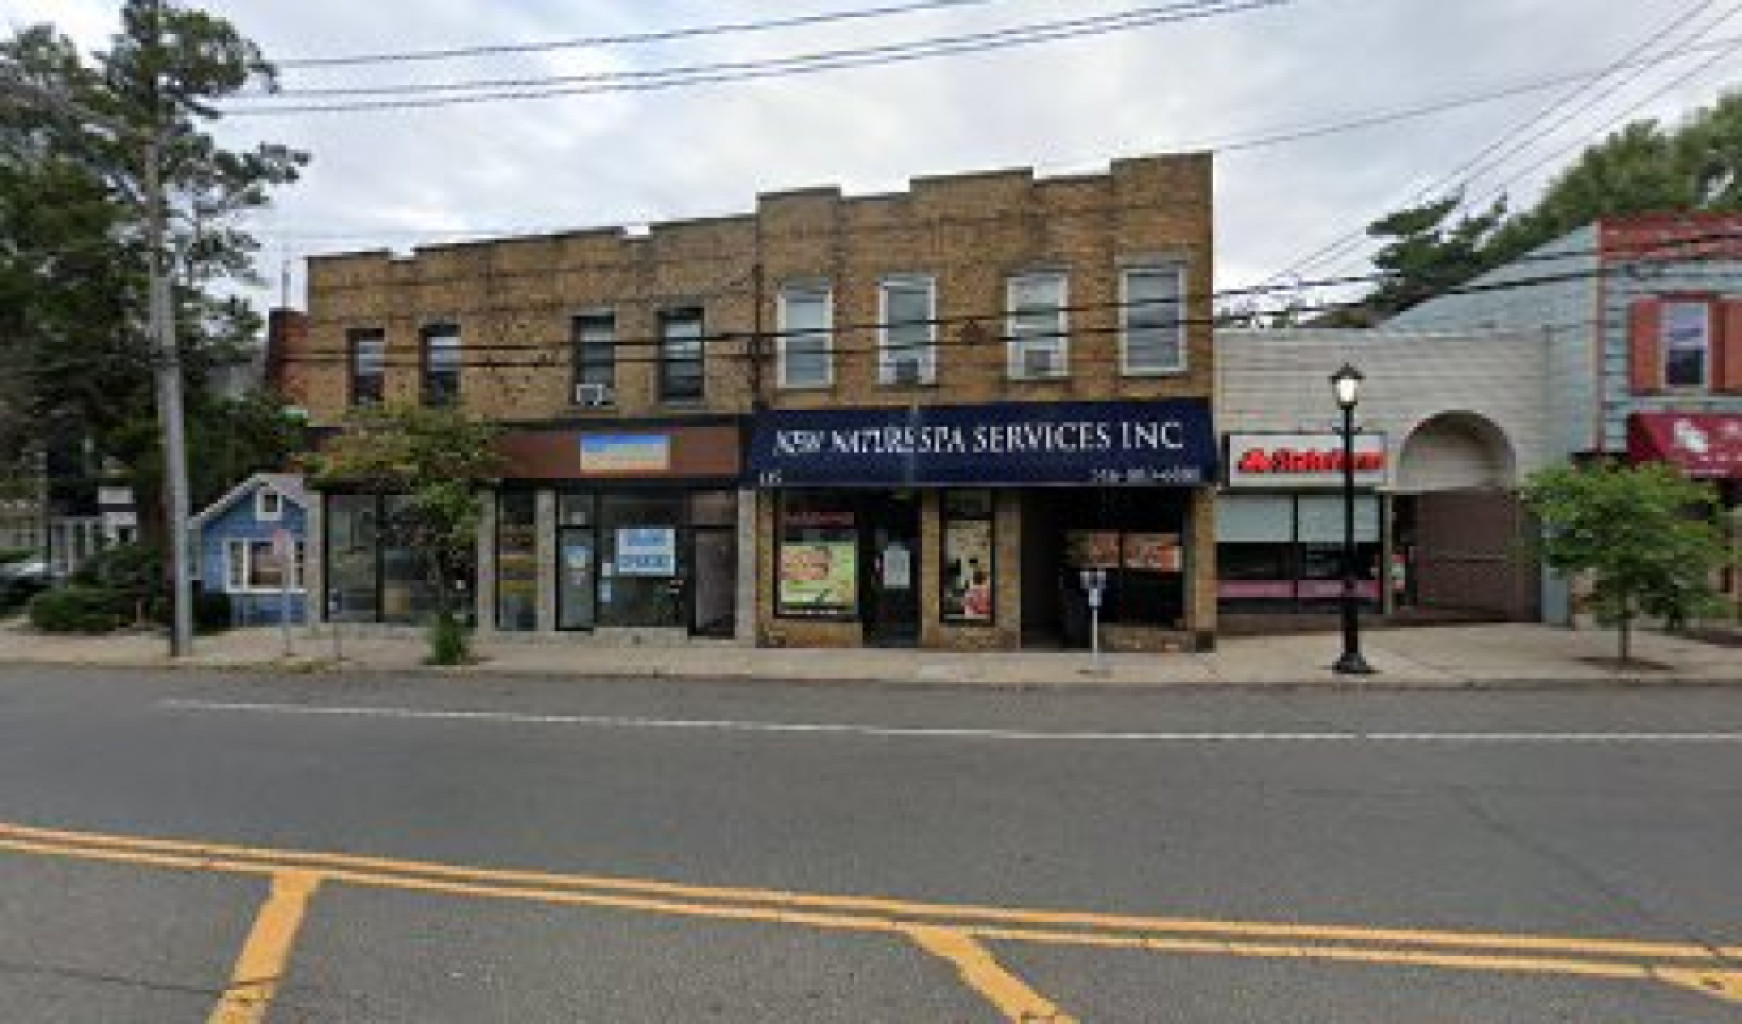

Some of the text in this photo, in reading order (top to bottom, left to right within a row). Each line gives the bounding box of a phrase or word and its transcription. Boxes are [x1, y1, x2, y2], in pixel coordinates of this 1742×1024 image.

[918, 426, 965, 453] SPA
[973, 422, 1111, 452] SERVICES
[1122, 421, 1184, 450] INC
